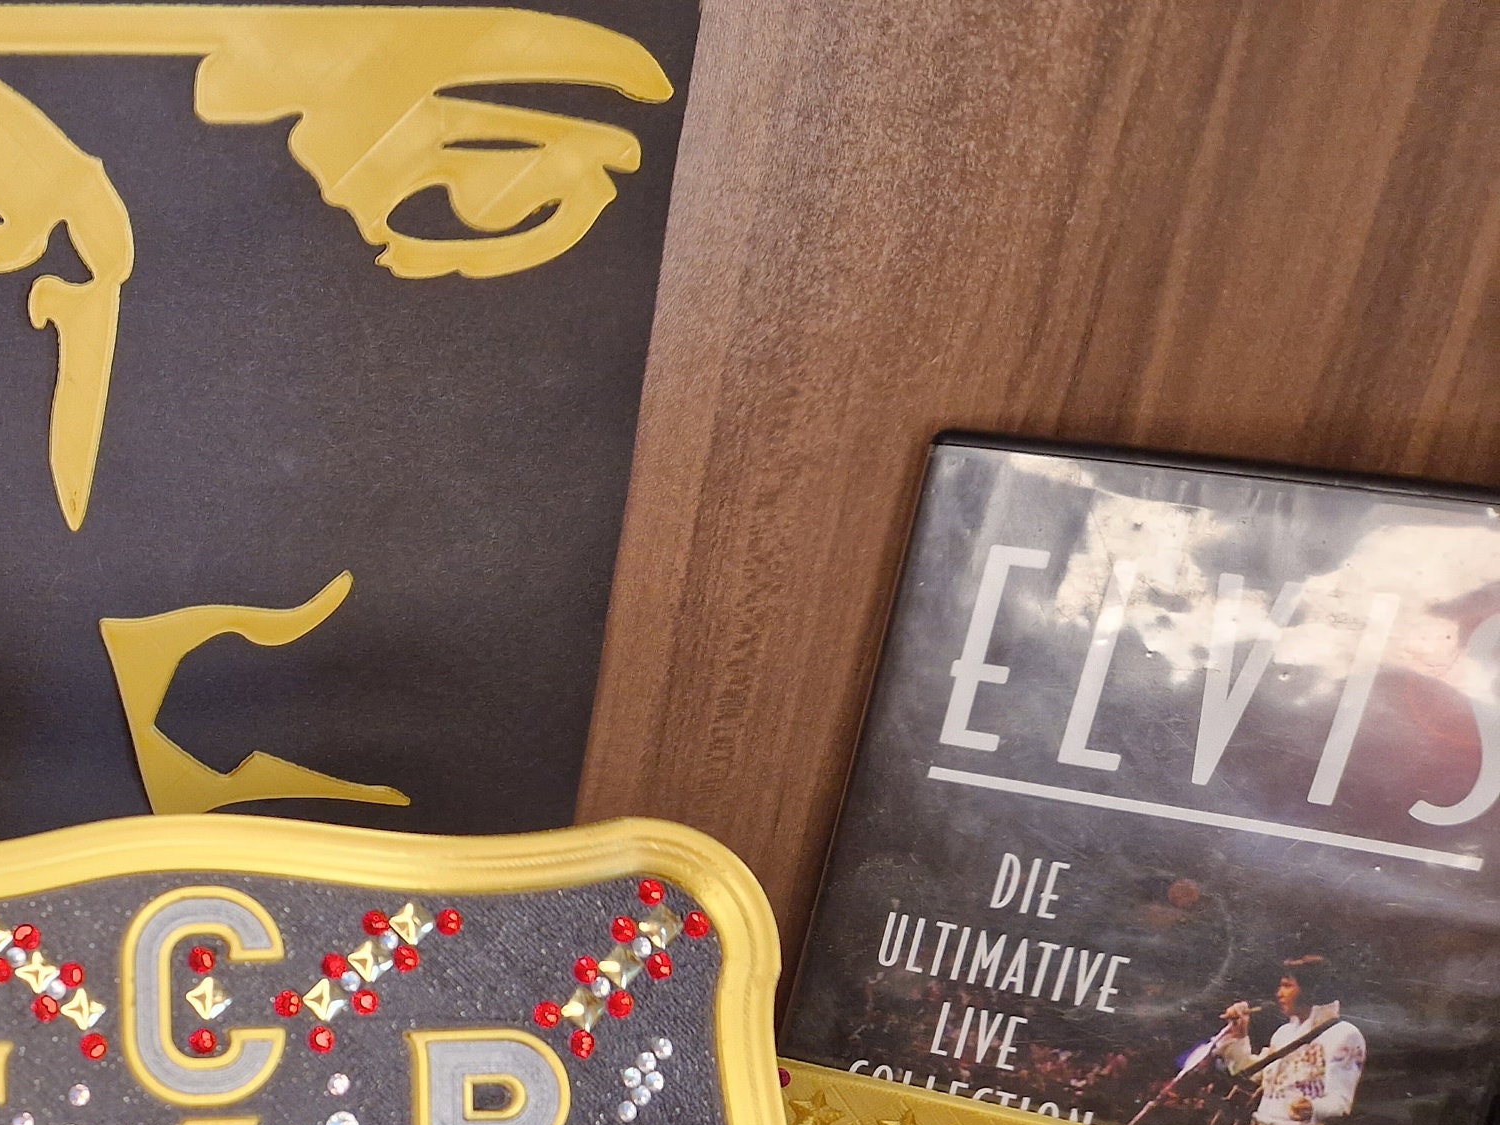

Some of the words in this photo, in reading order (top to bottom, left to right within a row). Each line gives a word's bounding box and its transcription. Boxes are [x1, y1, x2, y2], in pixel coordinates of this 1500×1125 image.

[938, 545, 1500, 826] ELVIS
[990, 853, 1071, 919] DIE
[878, 911, 1131, 1013] ULTIMATIVE
[930, 1001, 1028, 1071] LIVE
